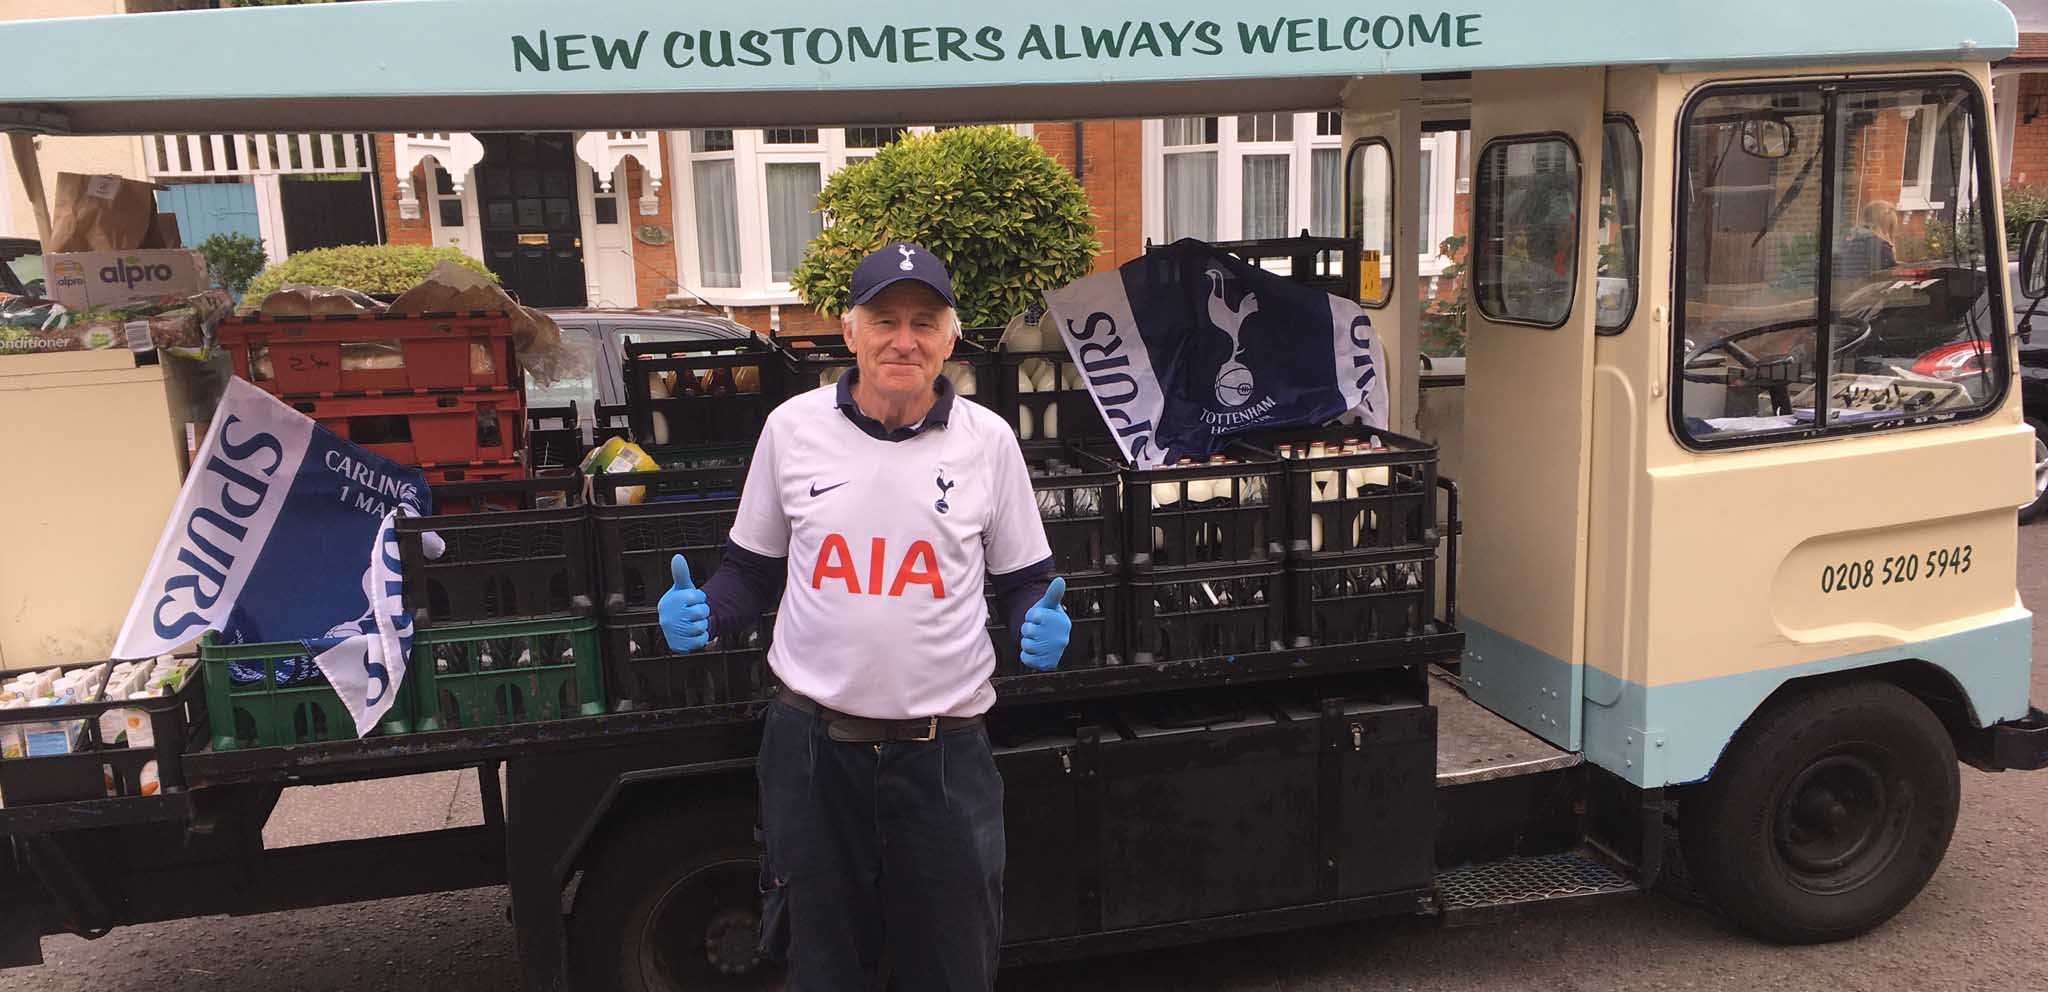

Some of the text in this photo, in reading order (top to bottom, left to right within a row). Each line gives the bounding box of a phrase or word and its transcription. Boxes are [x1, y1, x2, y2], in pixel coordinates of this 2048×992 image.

[511, 12, 1483, 73] NEW CUSTOMERS ALWAYS WELCOME
[57, 276, 84, 288] alpro
[99, 257, 173, 290] alpro
[1200, 395, 1277, 425] TOTTENHAM
[339, 485, 388, 520] 1 MA
[152, 414, 284, 640] SPURS
[811, 533, 946, 599] AIA
[1821, 544, 1973, 594] 0208 520 5943
